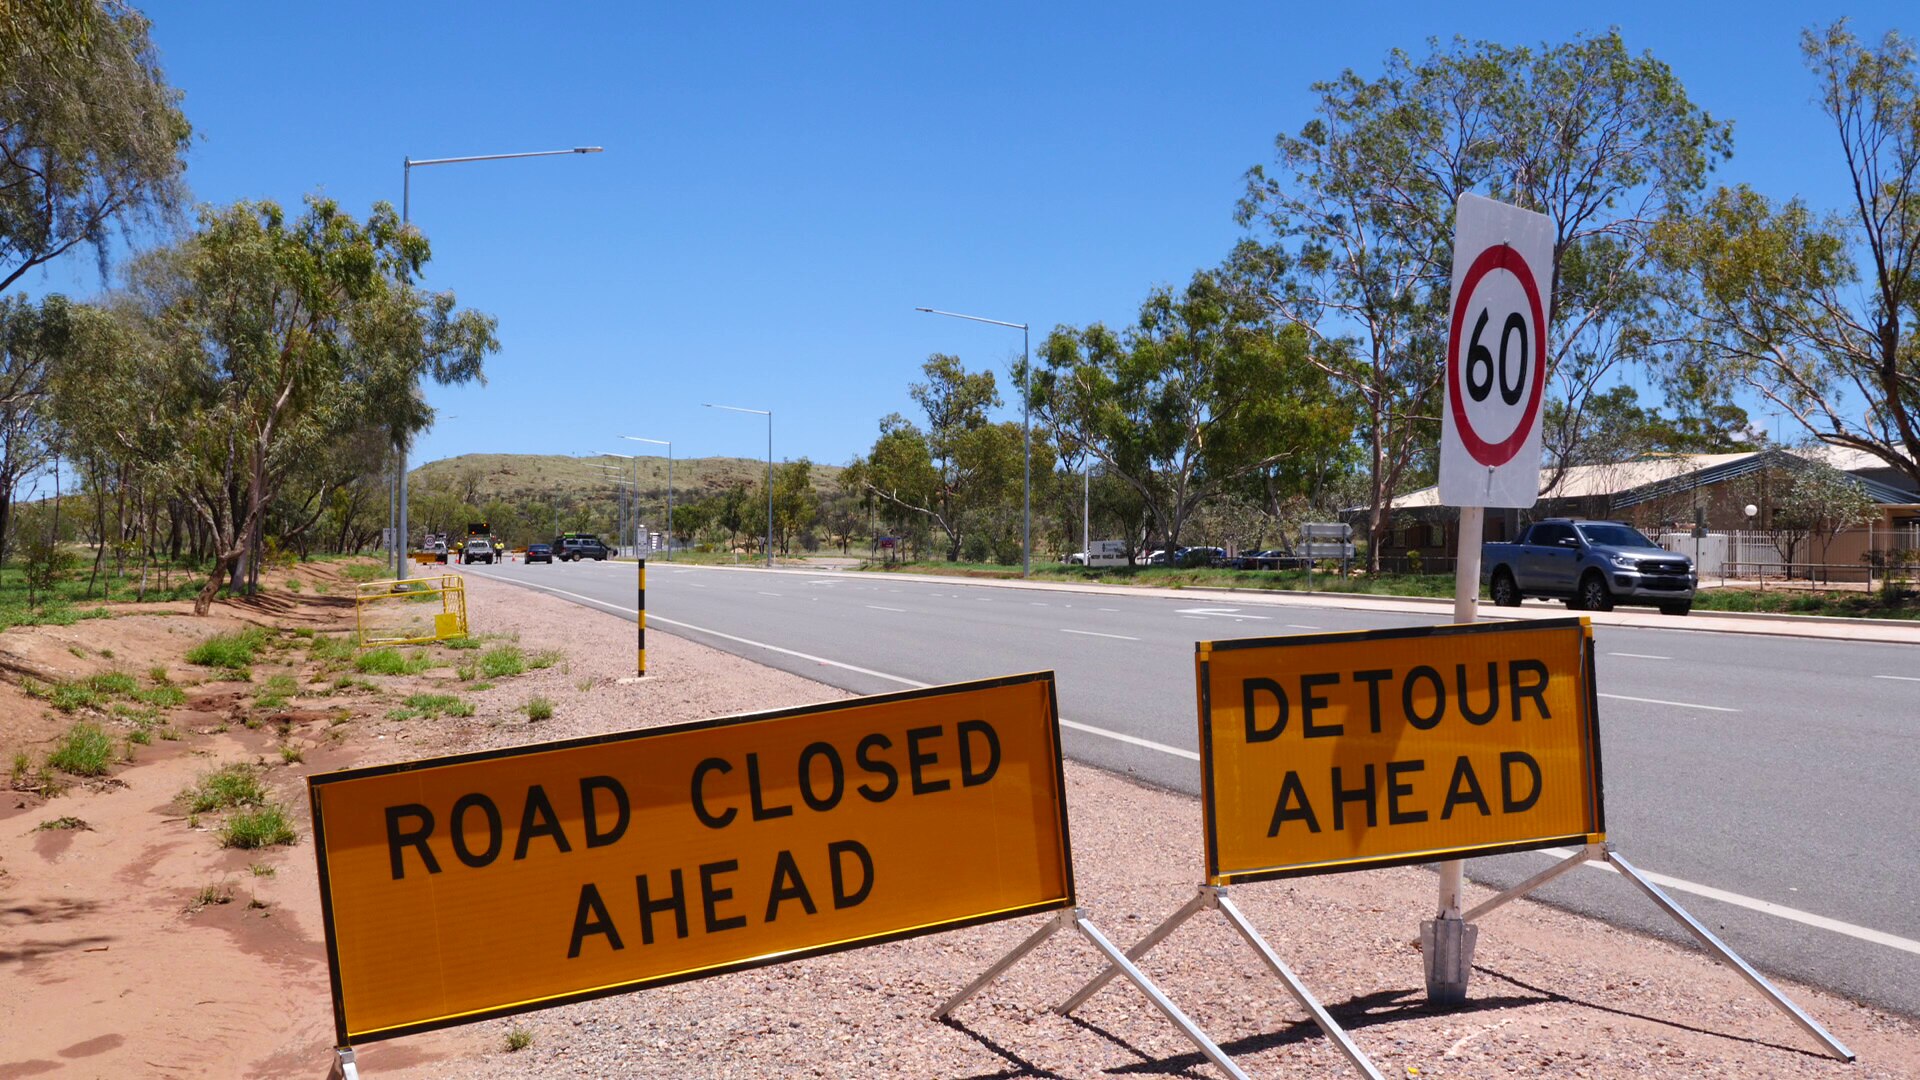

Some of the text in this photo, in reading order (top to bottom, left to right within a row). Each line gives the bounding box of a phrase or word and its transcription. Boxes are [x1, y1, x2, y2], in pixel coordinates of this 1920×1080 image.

[1465, 306, 1529, 406] 60
[1242, 658, 1551, 743] DETOUR
[384, 719, 1002, 880] ROAD CLOSED
[1267, 751, 1542, 838] AHEAD
[567, 839, 875, 959] AHEAD
